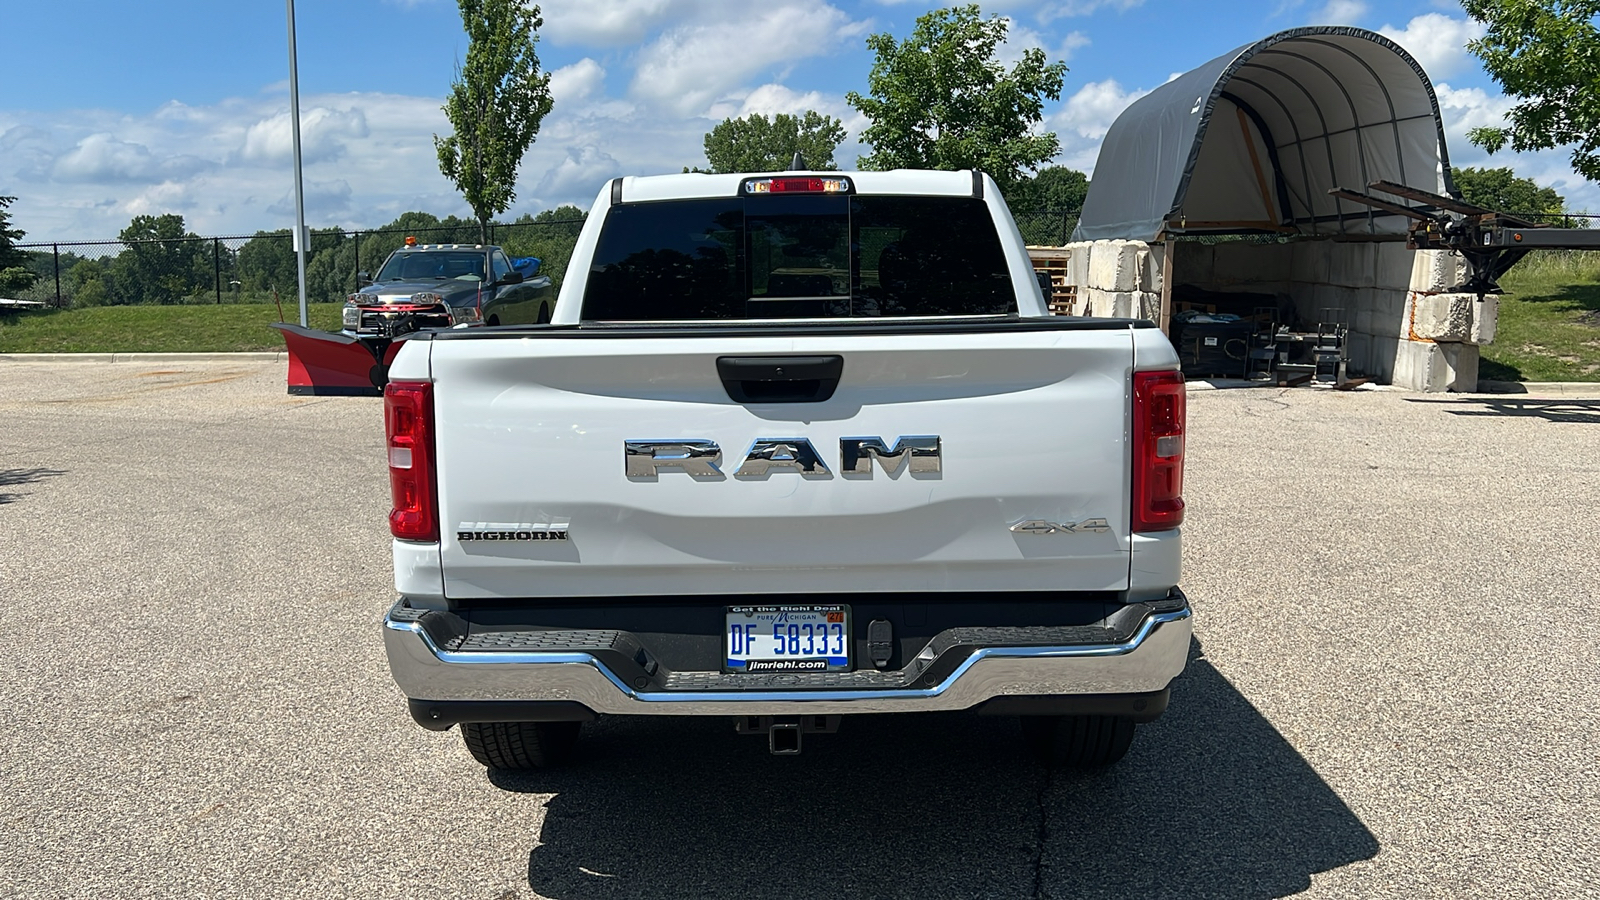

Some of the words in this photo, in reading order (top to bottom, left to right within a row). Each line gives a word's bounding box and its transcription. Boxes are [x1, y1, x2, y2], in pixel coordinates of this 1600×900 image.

[624, 435, 942, 480] RAM
[771, 612, 817, 624] MICHIGAN
[829, 612, 840, 620] 27
[731, 624, 757, 655] DF
[773, 624, 843, 655] 58333
[748, 661, 825, 671] jimriehl.com
